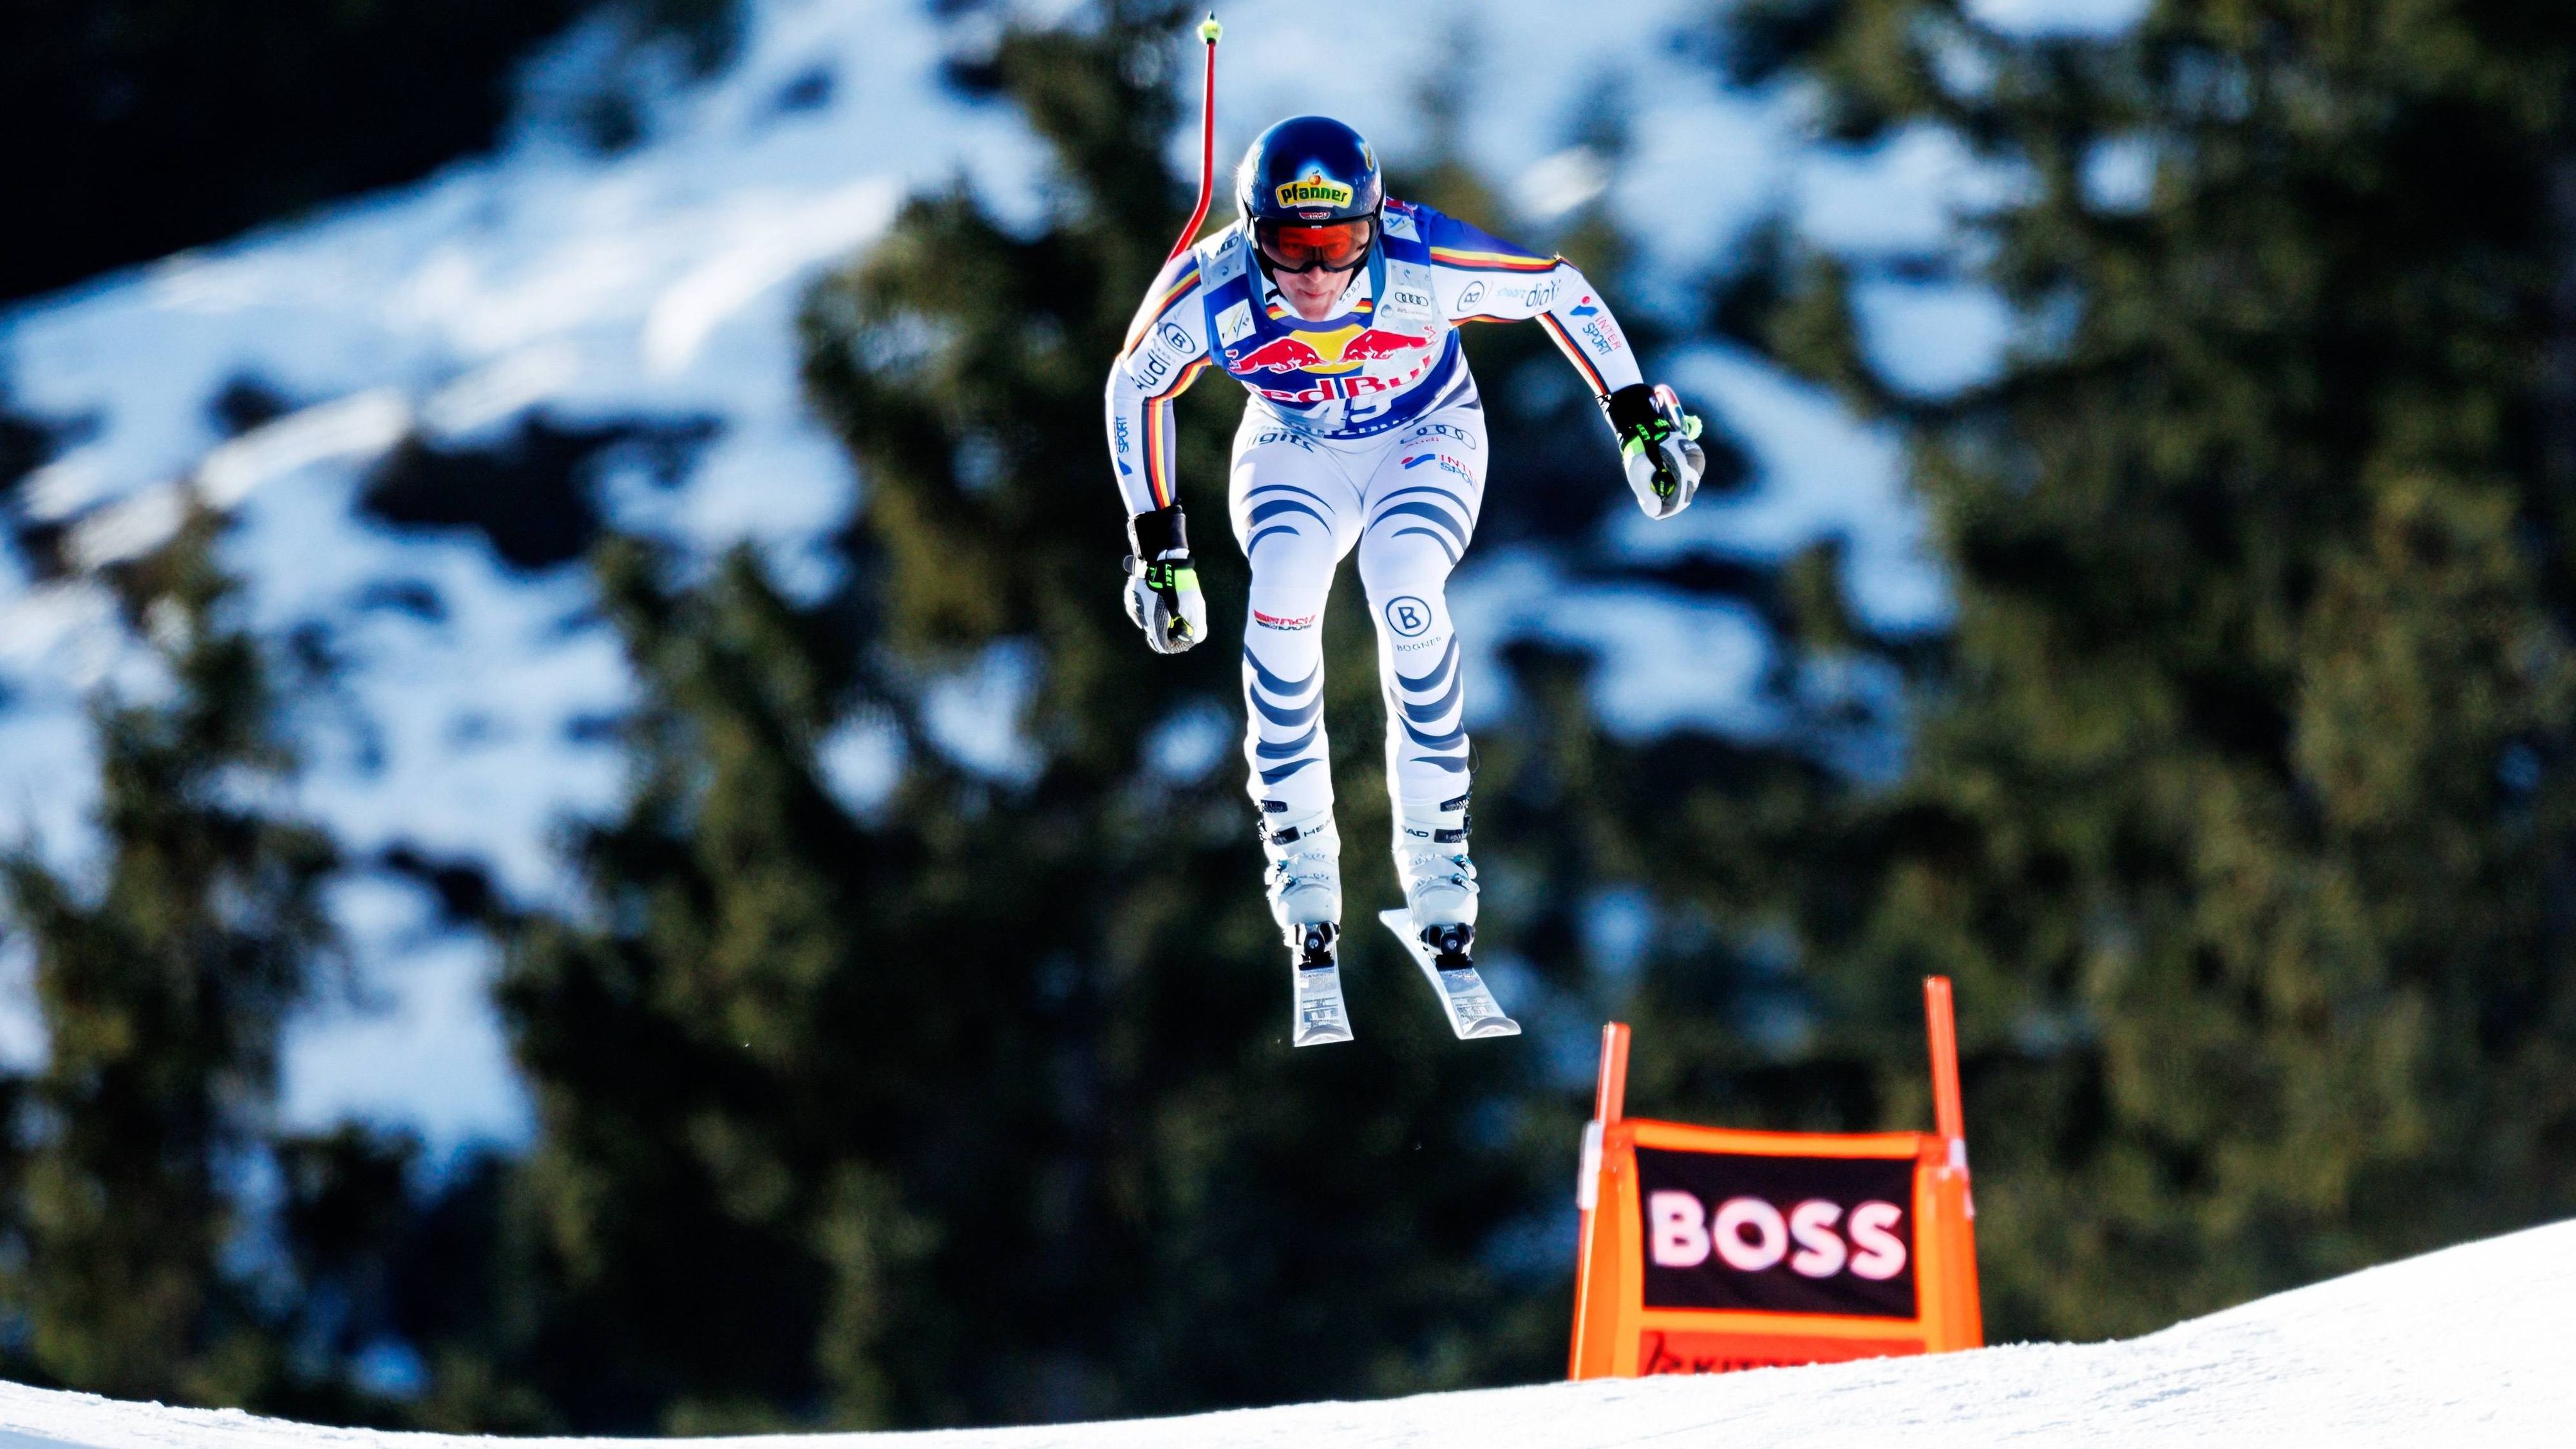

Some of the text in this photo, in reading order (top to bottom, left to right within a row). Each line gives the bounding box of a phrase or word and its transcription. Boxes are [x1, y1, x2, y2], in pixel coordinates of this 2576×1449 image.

[1281, 183, 1348, 204] pfanner
[1582, 322, 1613, 355] SPORT
[1595, 316, 1622, 350] INTER
[1115, 416, 1129, 453] SPORT
[1649, 1190, 1907, 1280] BOSS
